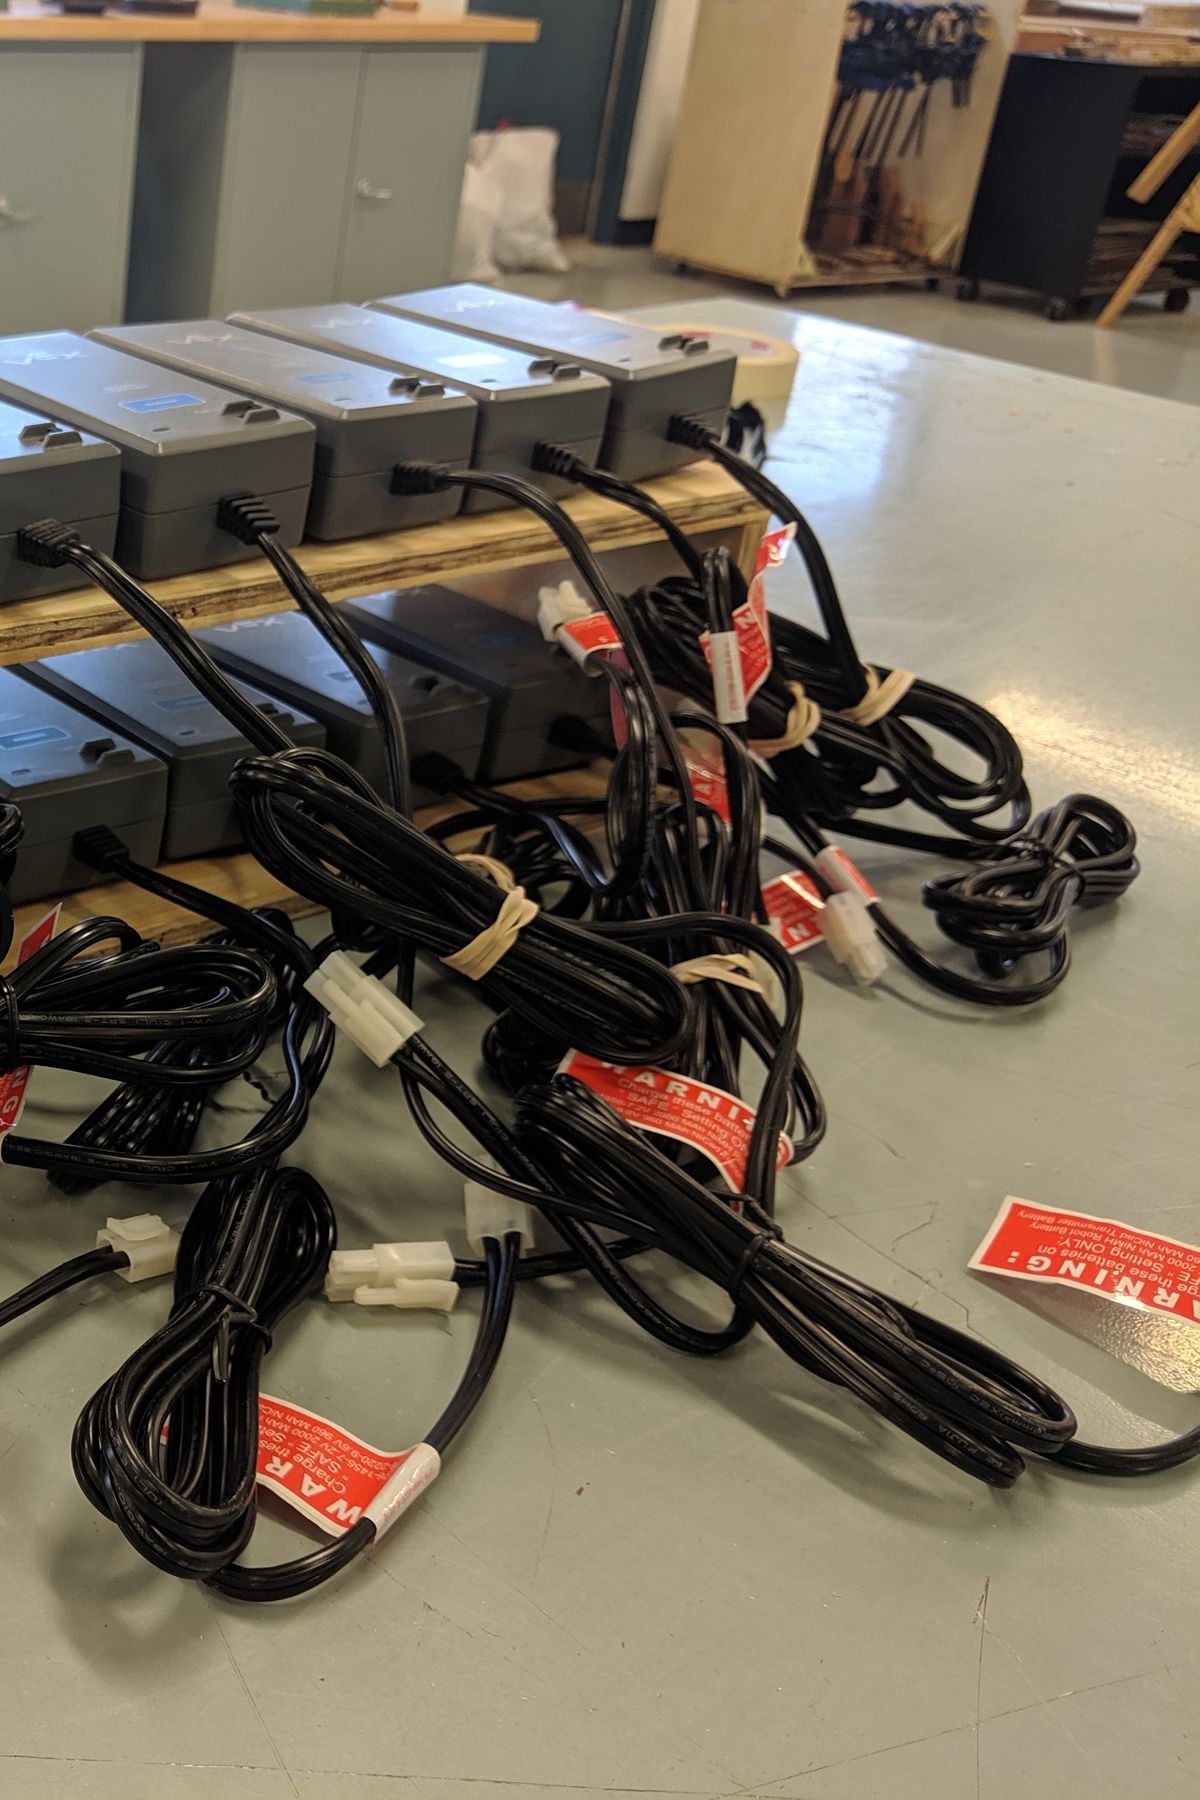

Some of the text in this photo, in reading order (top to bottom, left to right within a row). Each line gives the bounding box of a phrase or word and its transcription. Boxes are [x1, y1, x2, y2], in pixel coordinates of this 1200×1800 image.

[1017, 1209, 1057, 1225] Battery
[1030, 1221, 1068, 1236] Battery
[1057, 1217, 1117, 1237] Transmitter
[1069, 1228, 1104, 1242] Robot
[1037, 1245, 1174, 1289] these batteries on
[1109, 1248, 1165, 1273] Setting
[1167, 1257, 1197, 1272] 2000
[291, 1428, 320, 1444] 2000
[311, 1425, 335, 1440] 960
[292, 1452, 347, 1495] Charge
[264, 1455, 363, 1524] WAR
